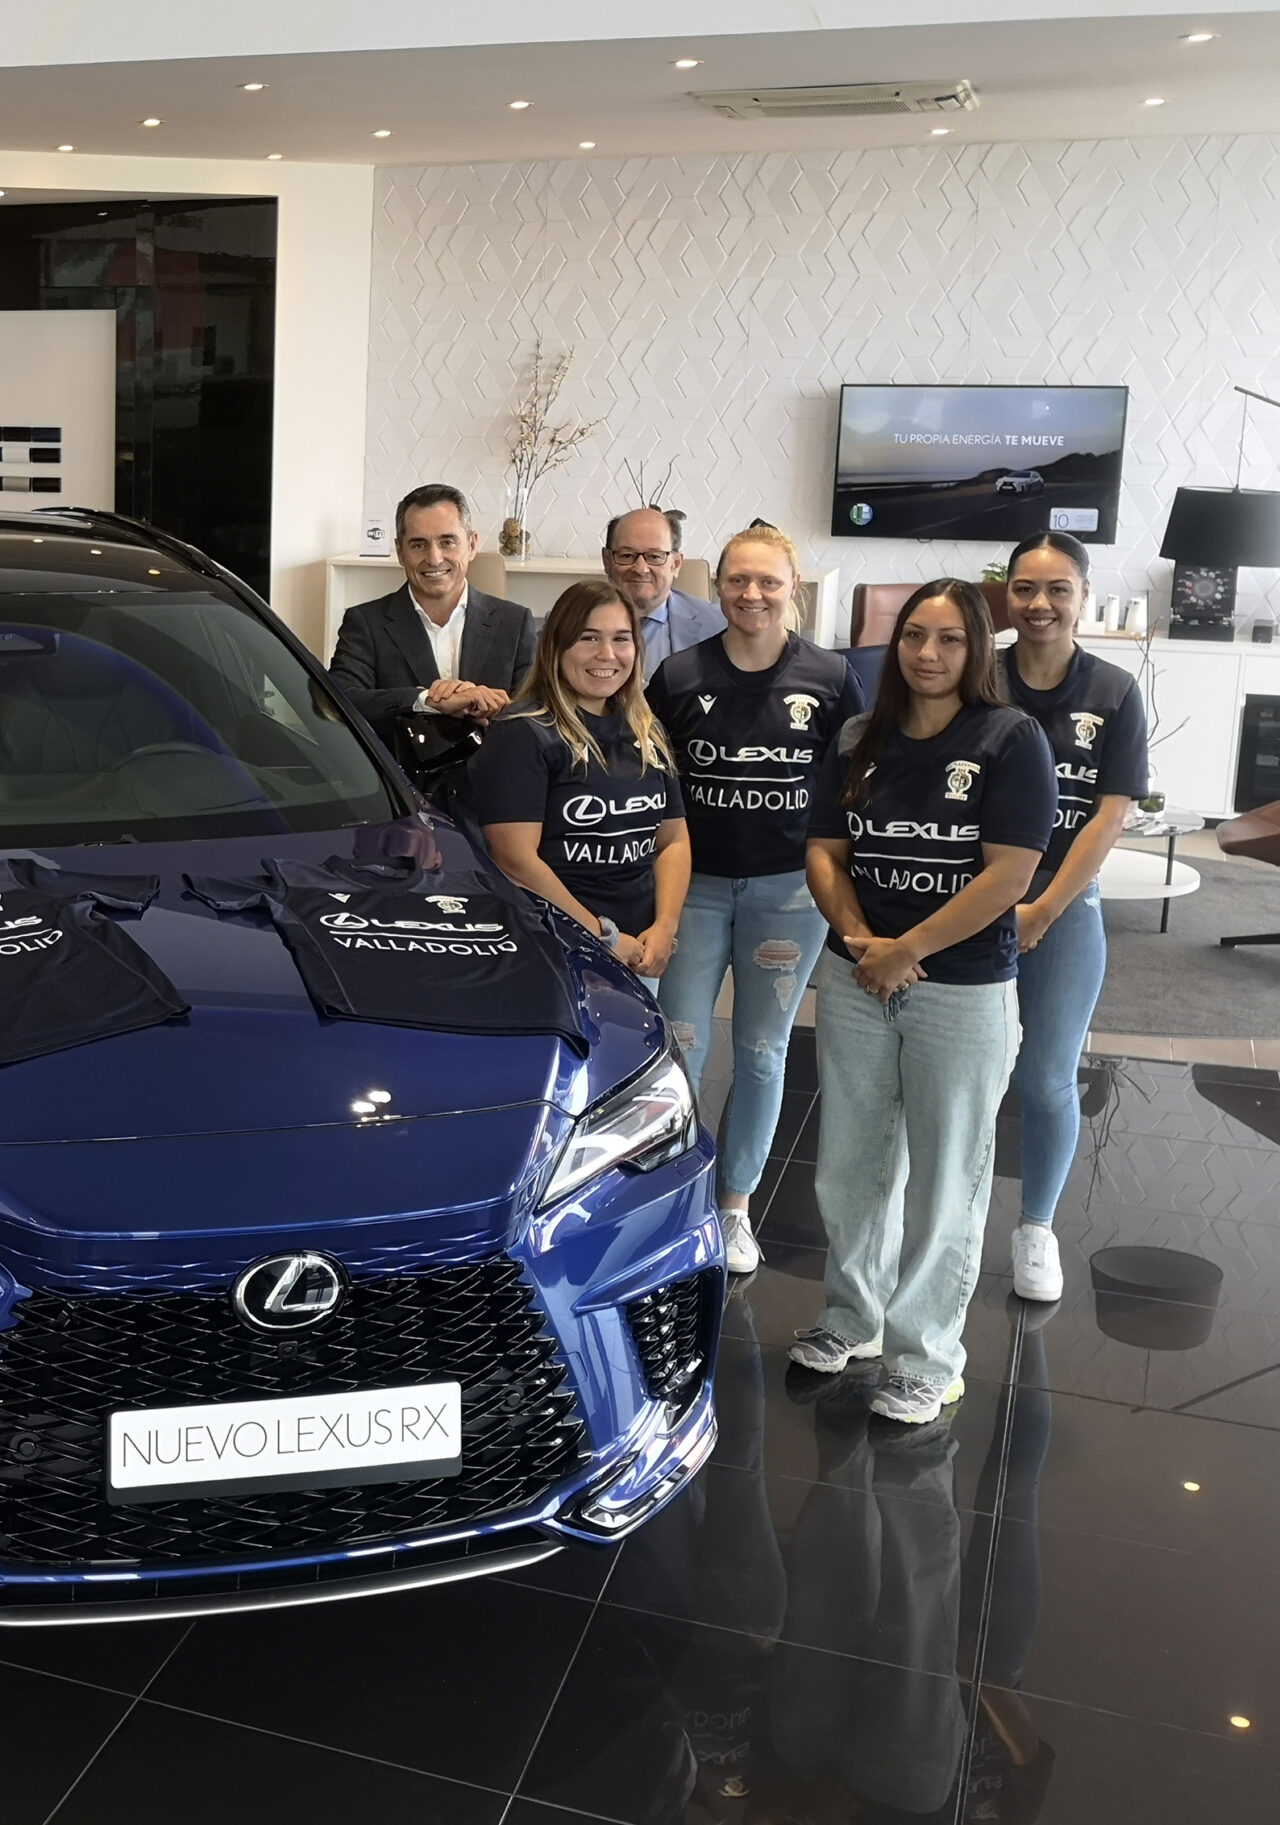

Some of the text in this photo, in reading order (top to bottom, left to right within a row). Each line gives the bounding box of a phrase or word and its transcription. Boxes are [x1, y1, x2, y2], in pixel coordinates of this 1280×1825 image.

[893, 432, 1065, 446] TU PROPIA ENERGÍA TE MUEVE
[1053, 514, 1069, 529] 10
[720, 746, 814, 764] LEXUS
[1054, 762, 1099, 784] XUS
[609, 792, 666, 815] LEXU
[865, 819, 980, 842] LEXUS
[563, 836, 657, 864] VALLADOL
[851, 864, 973, 894] LADOLID
[371, 918, 504, 932] LEXUS
[332, 937, 518, 956] VALLADOLID
[122, 1403, 450, 1467] NUEVO LEXUS RX
